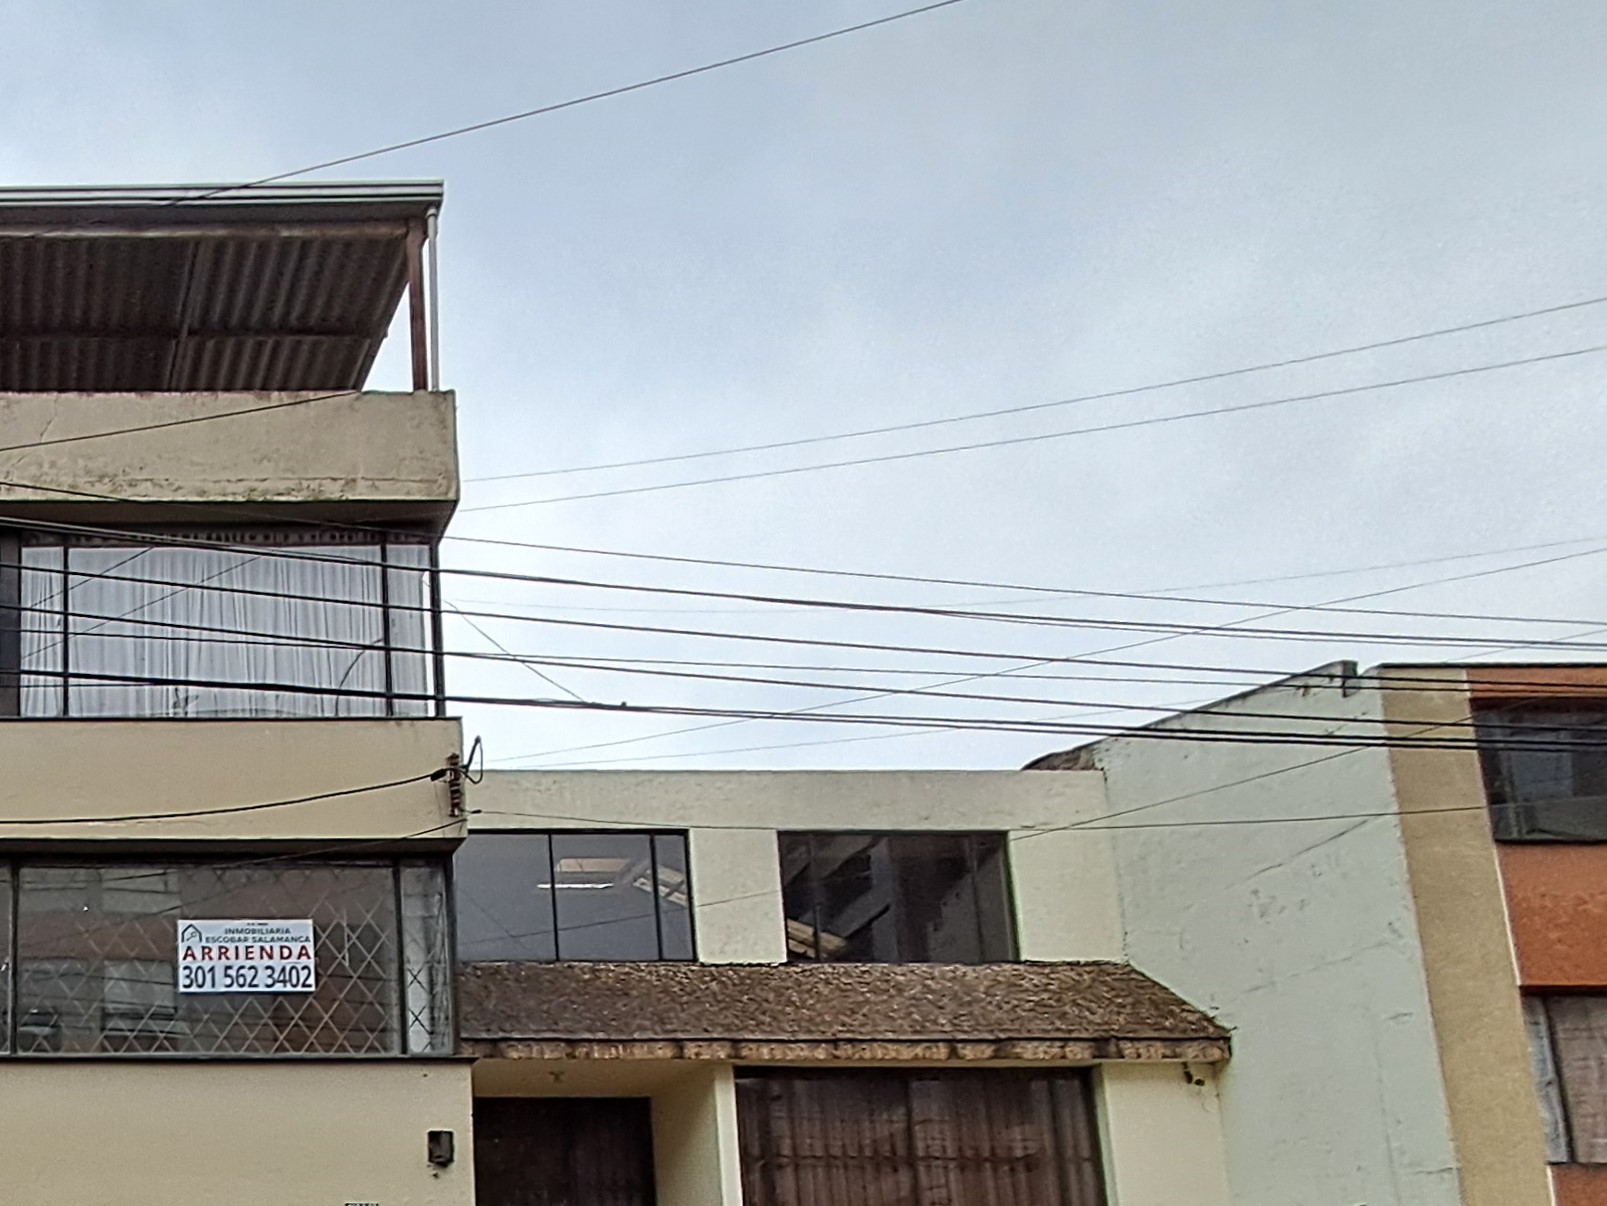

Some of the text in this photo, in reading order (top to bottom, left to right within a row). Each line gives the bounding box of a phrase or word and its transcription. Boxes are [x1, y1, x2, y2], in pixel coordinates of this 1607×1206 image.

[225, 927, 291, 935] INMOBILIARIA
[183, 946, 311, 960] ARRIENDA
[183, 965, 313, 988] 301 562 3402
